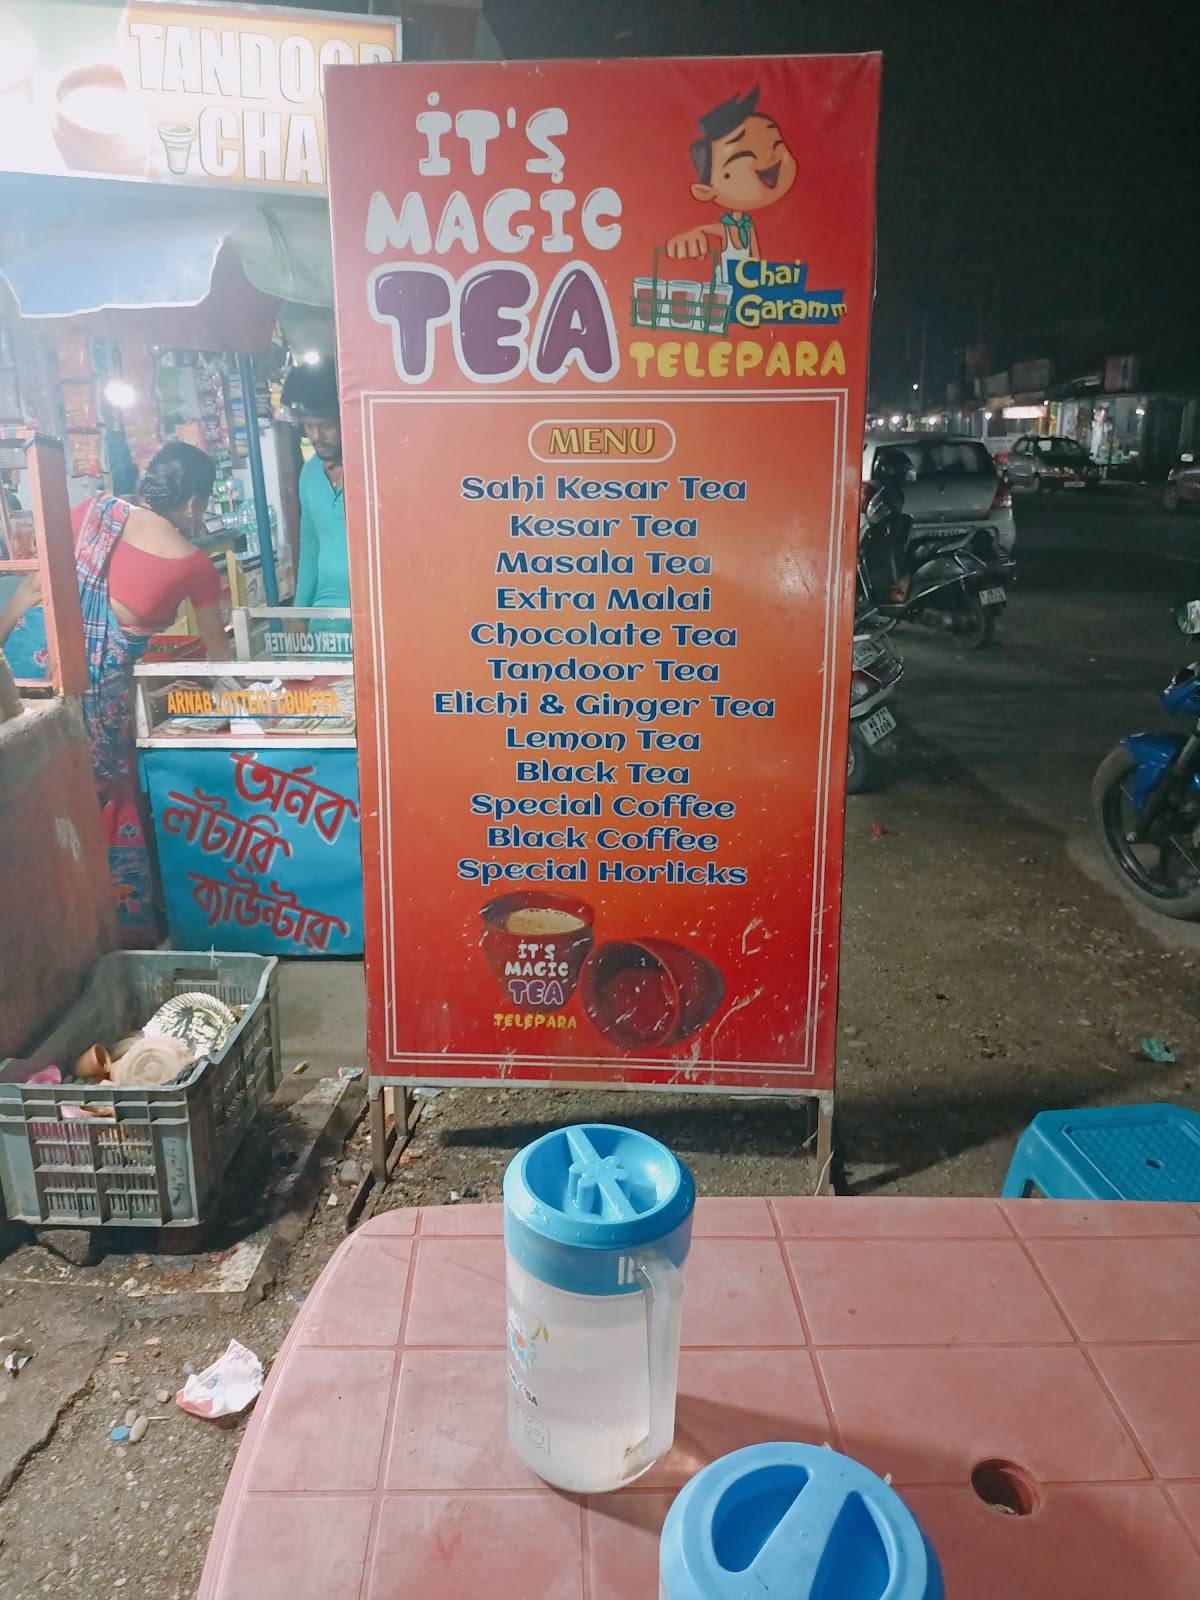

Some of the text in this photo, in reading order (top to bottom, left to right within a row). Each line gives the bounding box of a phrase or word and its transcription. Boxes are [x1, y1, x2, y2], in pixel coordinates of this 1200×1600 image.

[365, 186, 622, 255] MAGIC
[734, 256, 801, 288] Chai
[367, 259, 620, 384] TEA
[629, 340, 846, 378] TELEPARA
[548, 427, 656, 455] MENU
[460, 475, 747, 503] Sahi Kesar Tea
[510, 513, 698, 538] Kesar Tea
[495, 549, 712, 575] Masala Tea
[496, 586, 711, 612] Extra Malai
[469, 622, 738, 648] Chocolate Tea
[486, 657, 720, 683] Tandoor Tea
[168, 690, 211, 714] ARNAB
[277, 690, 337, 714] COUNTER
[434, 690, 776, 722] Elichi & Ginger Tea
[505, 727, 701, 752] Lemon Tea
[516, 760, 690, 785] Black Tea
[470, 793, 736, 821] Special Coffee
[162, 787, 292, 874] লটারি
[487, 826, 719, 852] Black Coffee
[457, 858, 748, 886] Special Horlicks
[517, 939, 555, 961] IT'S
[504, 961, 569, 977] MAGIC
[508, 979, 564, 1005] TEA
[494, 1013, 577, 1030] TELEPARA
